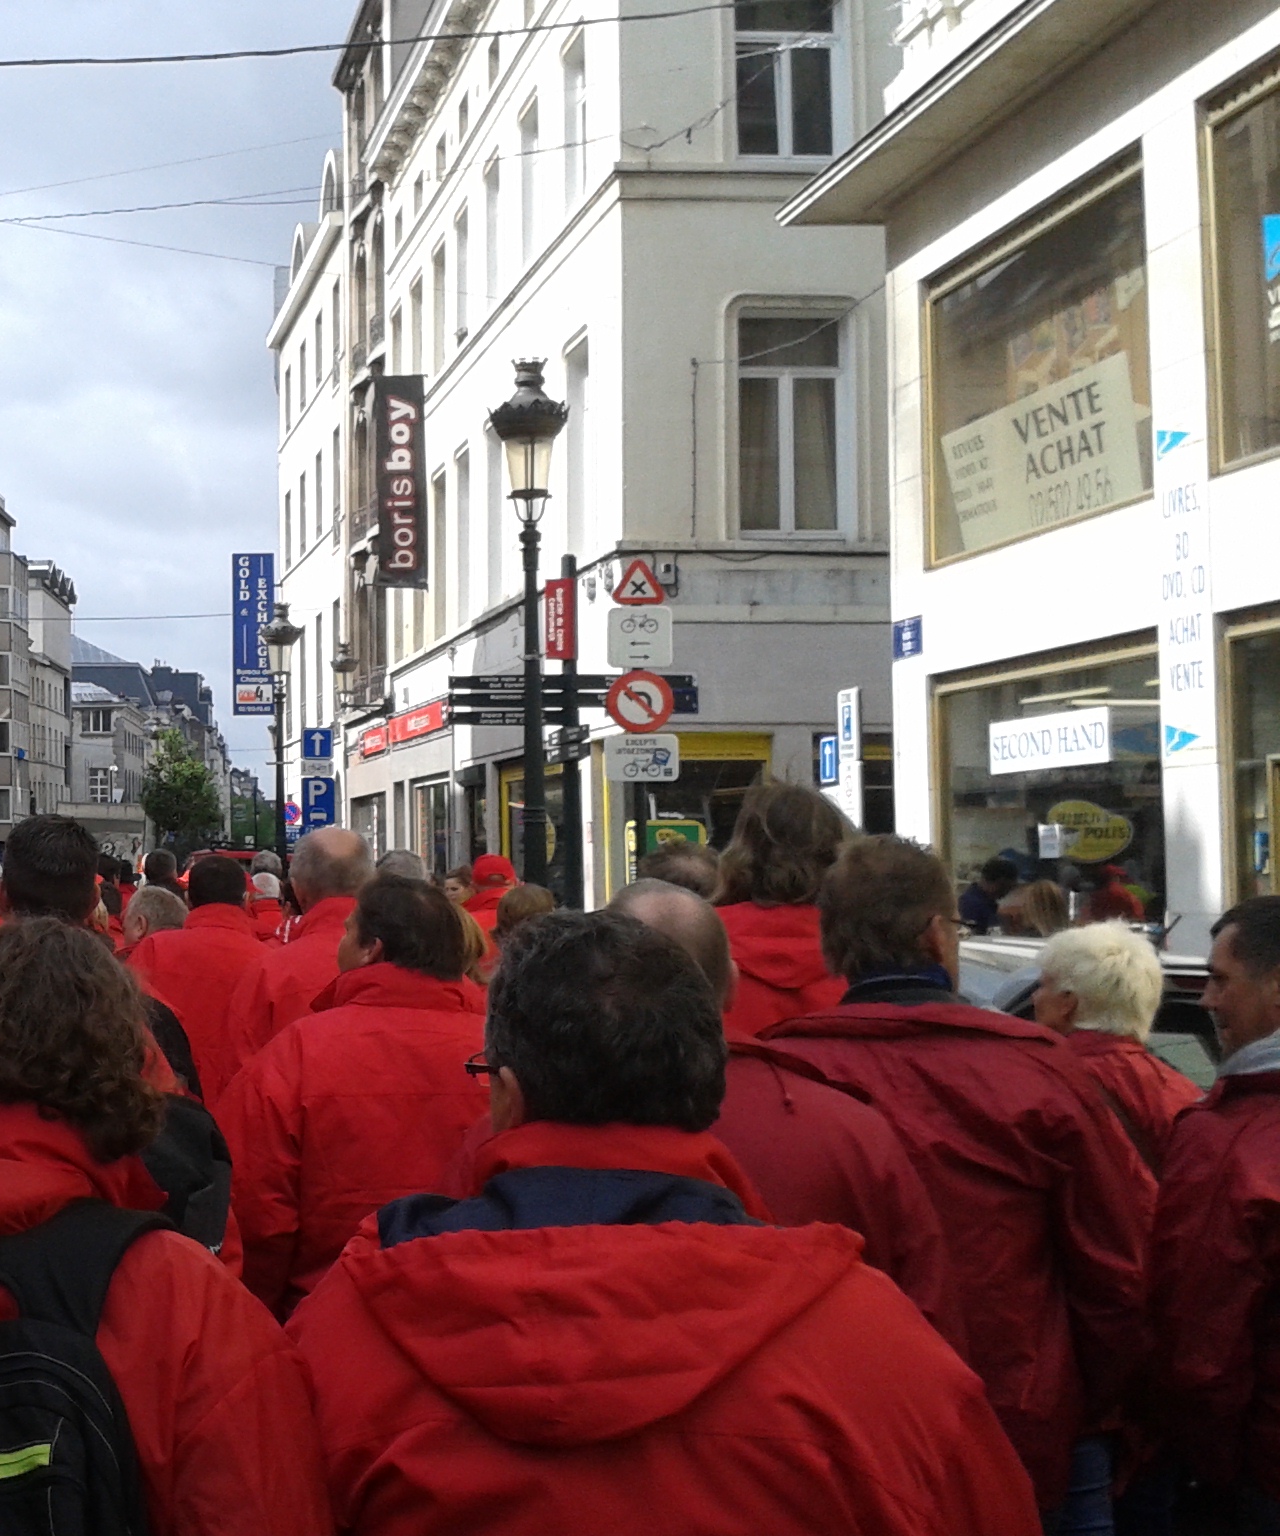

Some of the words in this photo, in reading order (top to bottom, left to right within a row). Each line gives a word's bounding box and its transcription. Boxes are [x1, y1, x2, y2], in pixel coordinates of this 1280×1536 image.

[1011, 381, 1102, 444] VENTE
[1025, 421, 1106, 484] ACHAT
[238, 556, 250, 601] GOLD
[1191, 565, 1205, 594] CD
[256, 577, 269, 668] EXCHANGE
[1169, 613, 1202, 646] ACHAT
[1170, 660, 1205, 691] VENTE
[993, 729, 1053, 761] SECOND
[1057, 721, 1105, 754] HAND
[308, 780, 327, 806] P
